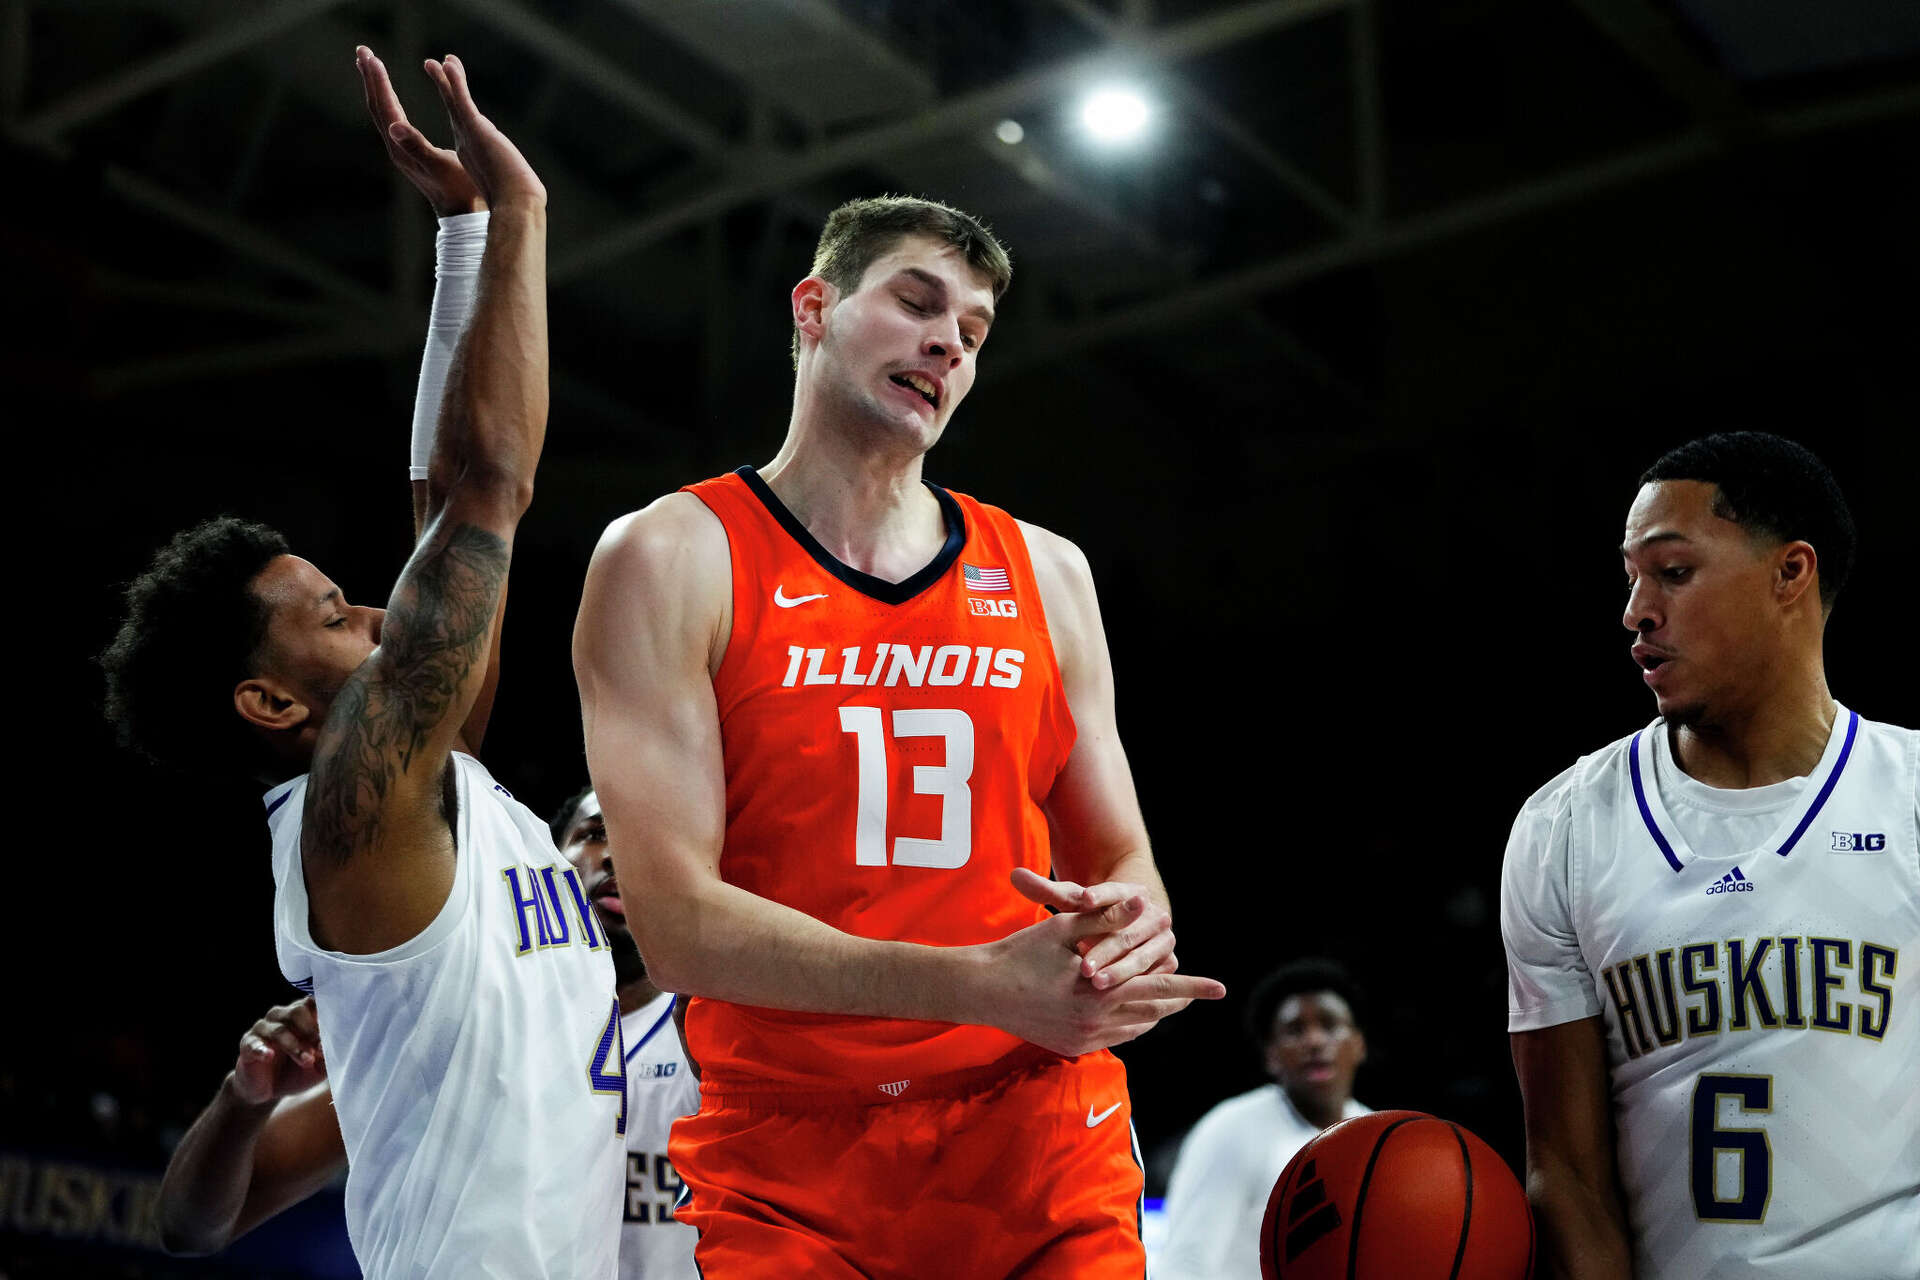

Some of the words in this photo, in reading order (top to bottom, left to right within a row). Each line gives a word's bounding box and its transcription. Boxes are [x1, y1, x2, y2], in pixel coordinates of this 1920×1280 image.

[782, 643, 1025, 688] ILLINOIS
[839, 706, 974, 869] 13
[1705, 880, 1754, 896] adidas
[1602, 936, 1898, 1060] HUSKIES
[586, 999, 626, 1139] 4
[1690, 1073, 1773, 1224] 6
